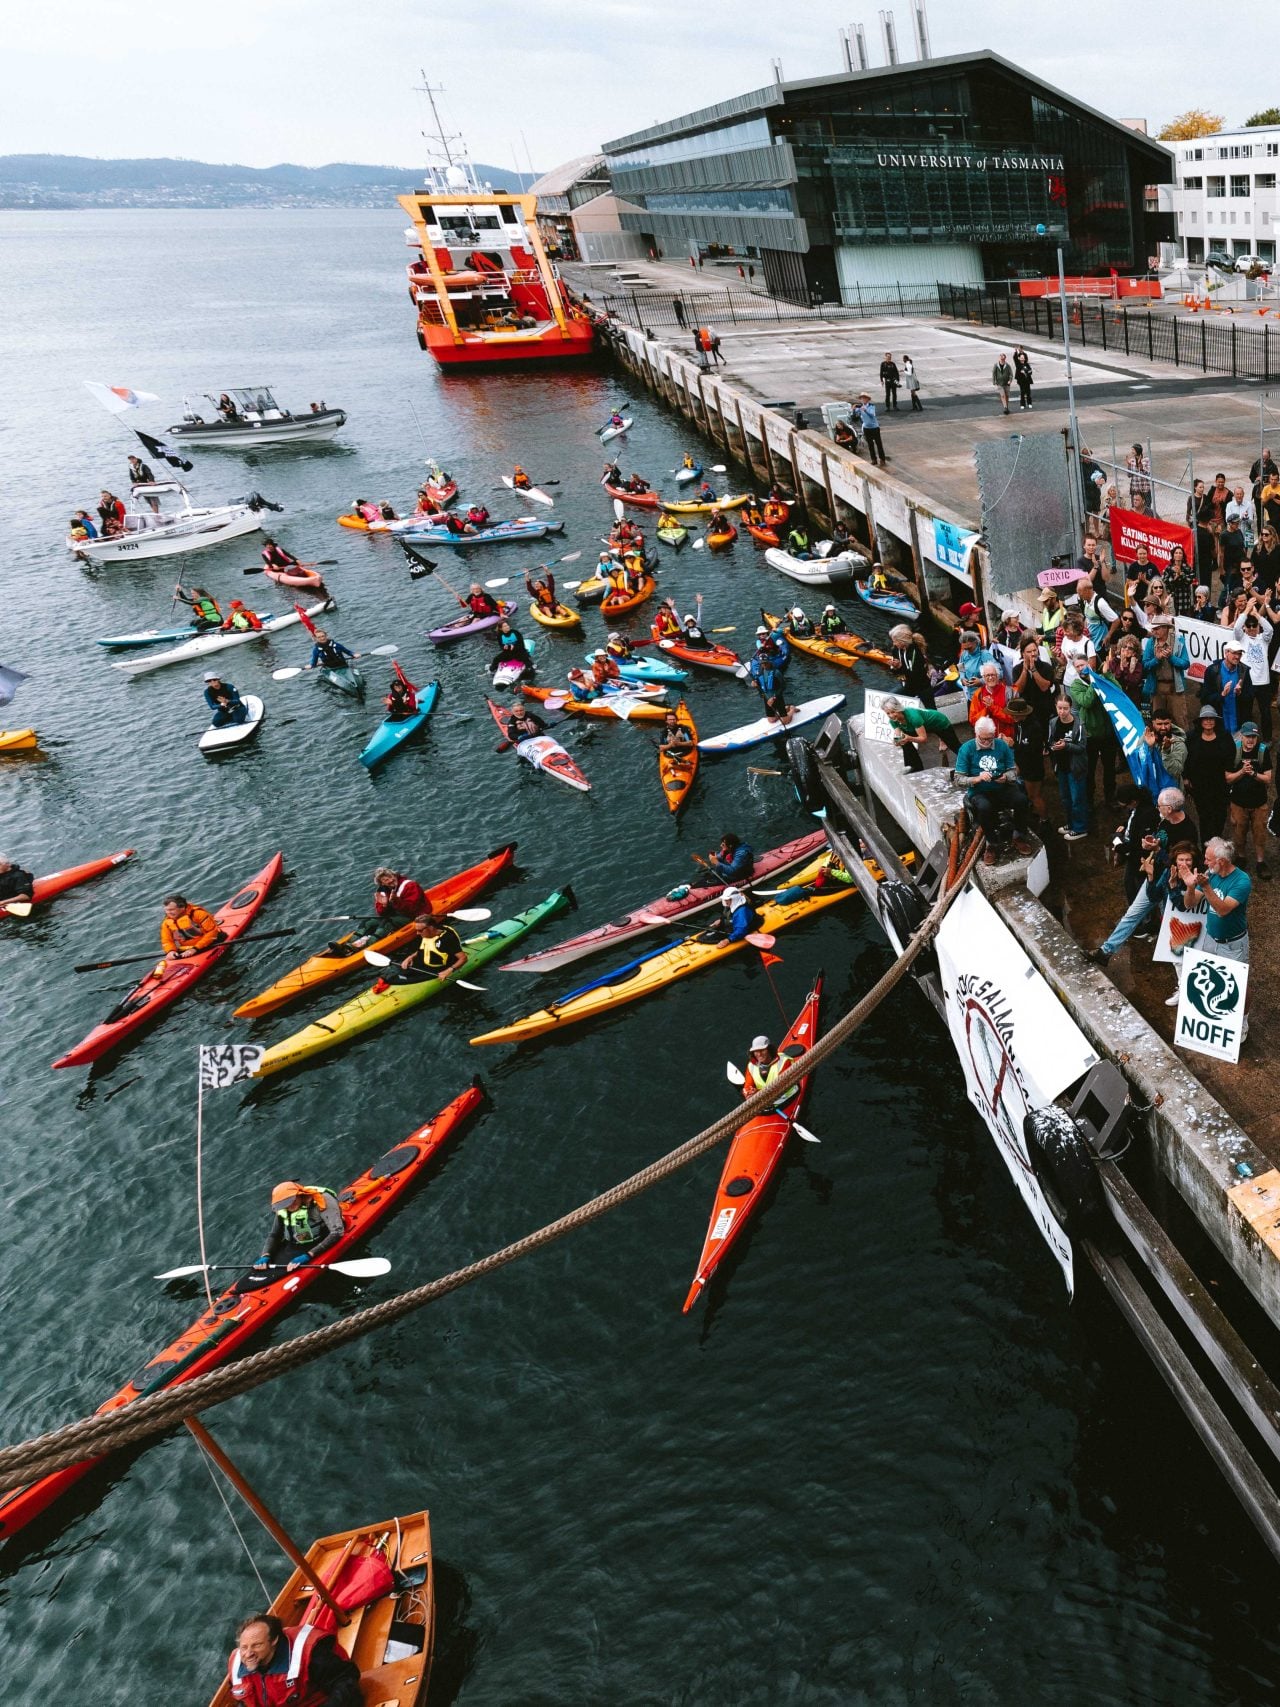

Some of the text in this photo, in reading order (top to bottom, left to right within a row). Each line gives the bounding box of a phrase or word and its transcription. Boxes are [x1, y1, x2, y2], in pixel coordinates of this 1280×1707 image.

[877, 154, 1064, 171] UNIVERSITY of TASMANIA
[1121, 526, 1183, 551] EATING SALMO
[1148, 545, 1172, 562] TASMA
[1043, 570, 1070, 582] TOXIC
[1181, 1015, 1235, 1048] NOFF
[203, 1045, 260, 1068] RAP
